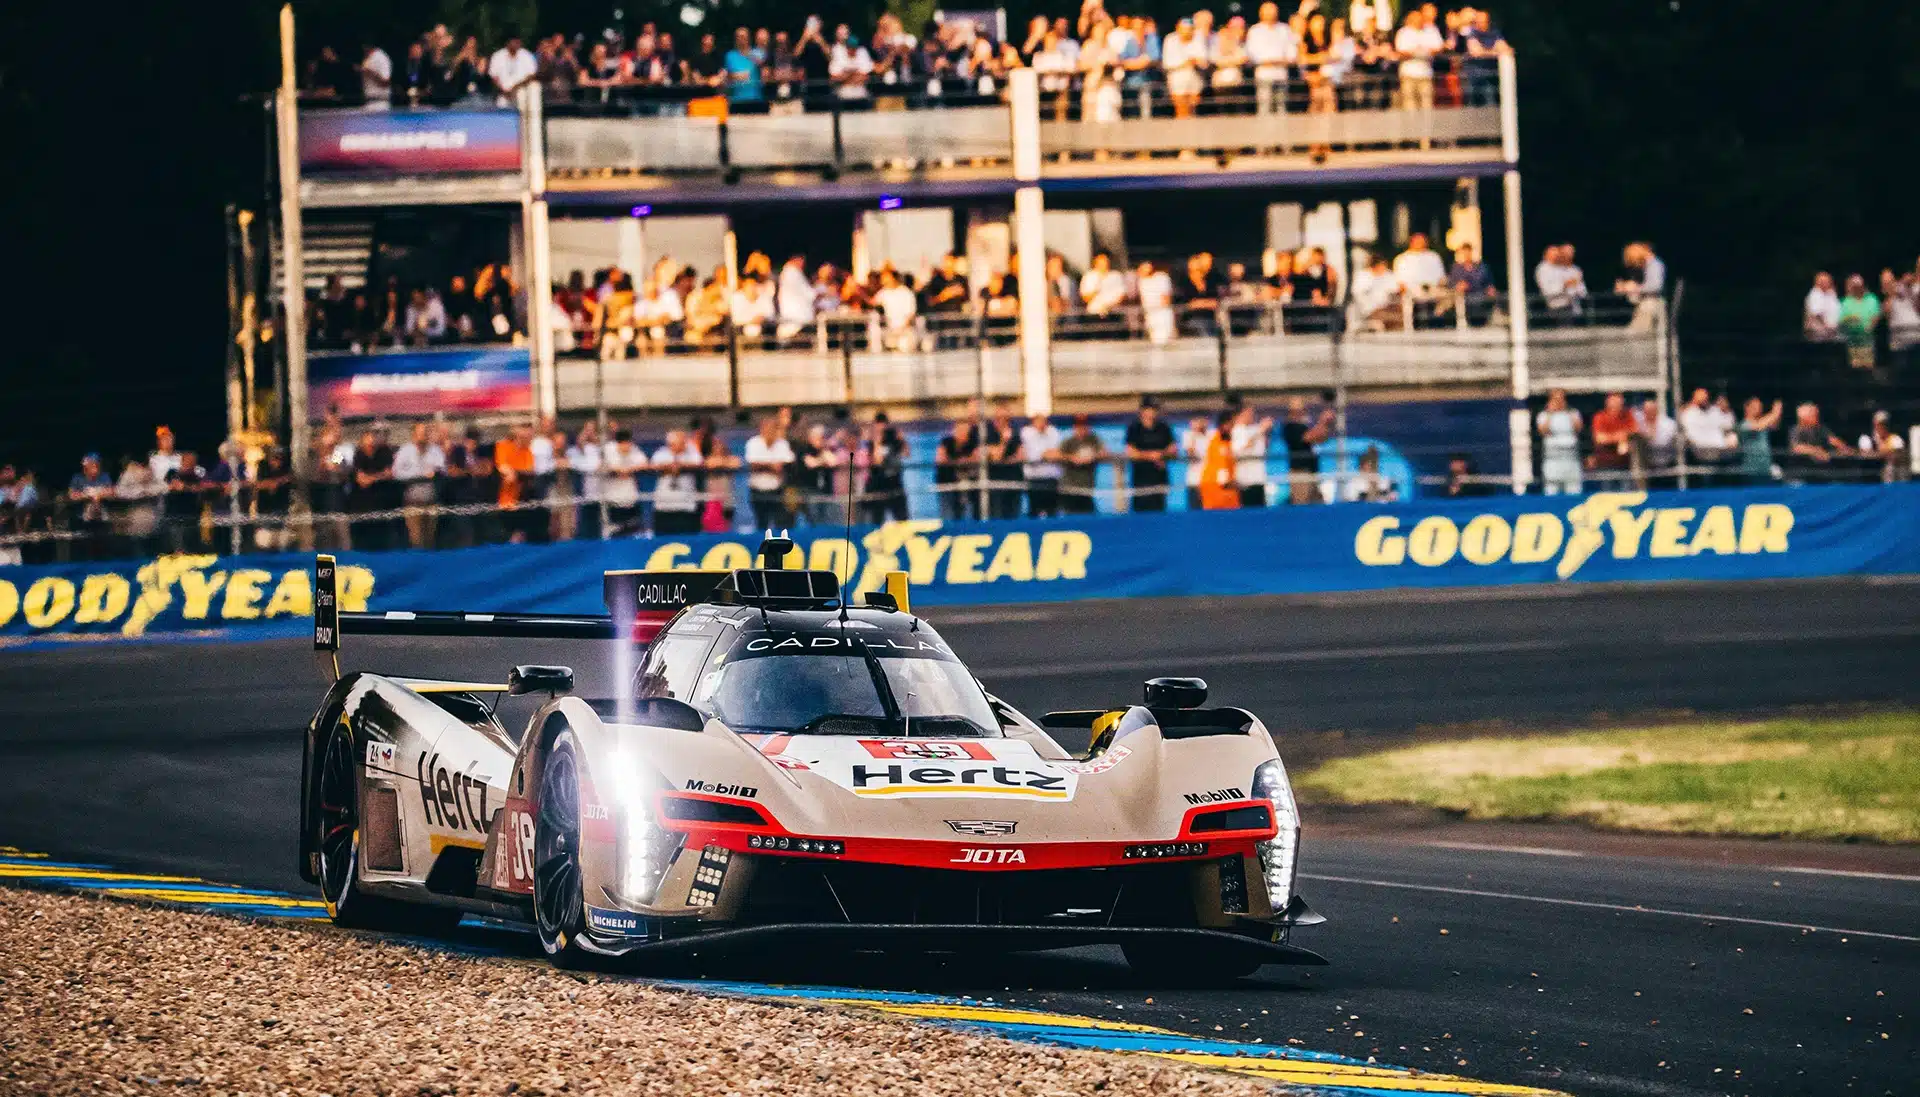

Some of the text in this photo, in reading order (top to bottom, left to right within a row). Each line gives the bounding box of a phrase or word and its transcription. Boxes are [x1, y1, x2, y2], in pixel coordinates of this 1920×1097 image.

[1355, 503, 1795, 567] GOODYEAR
[638, 584, 687, 604] CADILLAC
[852, 764, 1067, 790] Hertz
[418, 751, 494, 835] Hertz
[685, 779, 739, 797] Mobil
[1184, 789, 1231, 805] Mobil
[510, 810, 536, 881] 38
[950, 848, 1027, 864] JOTA
[593, 915, 637, 929] MICHELIN
